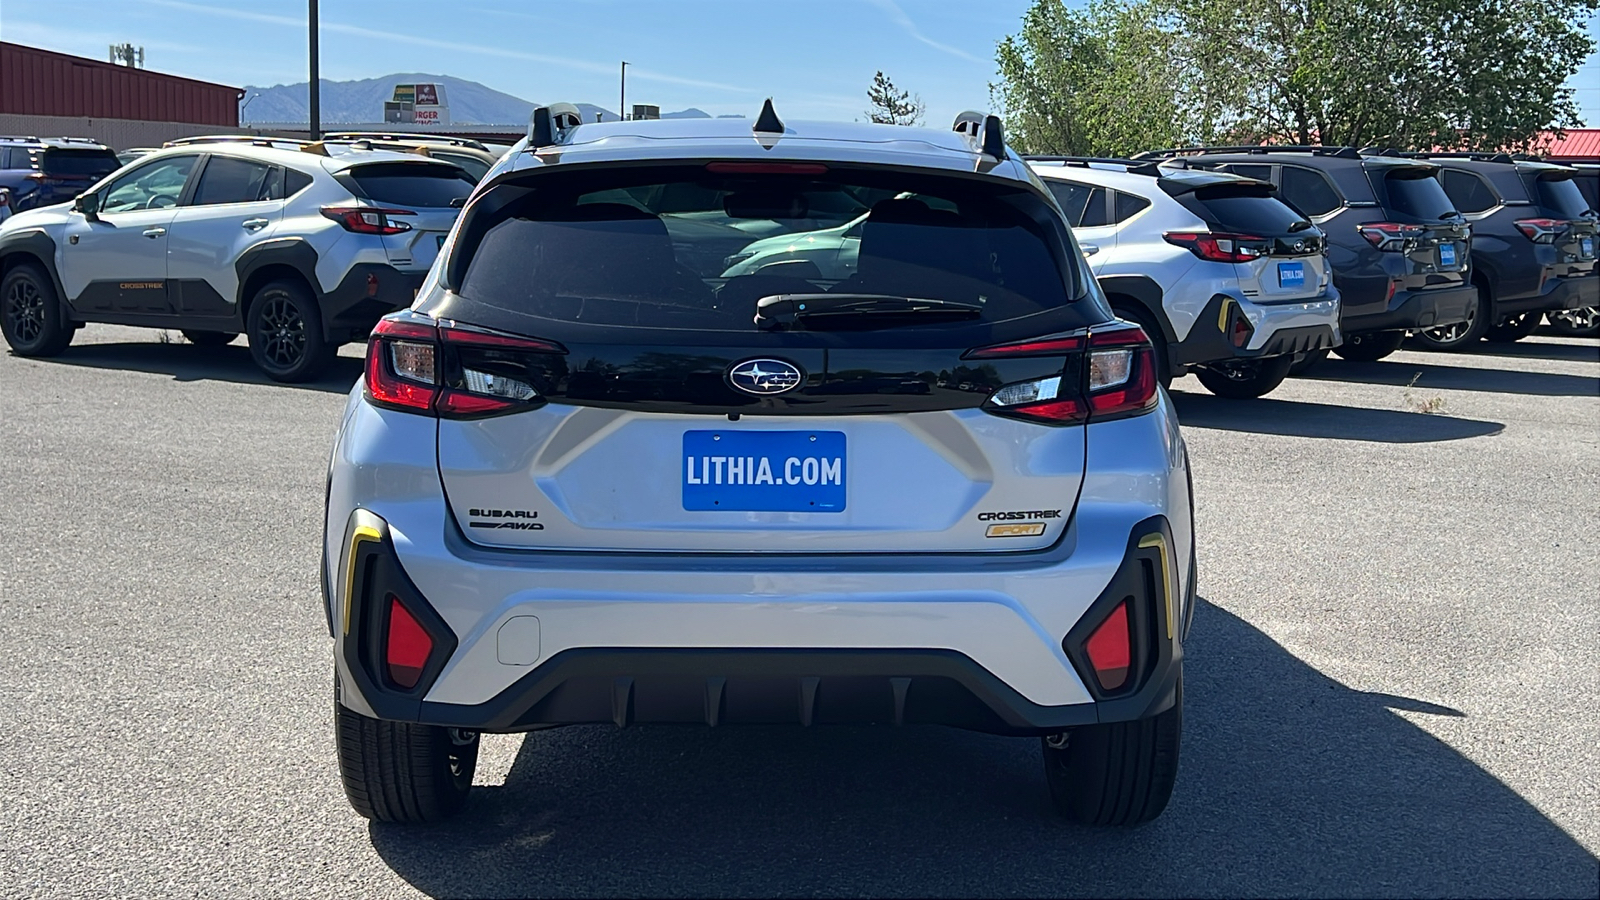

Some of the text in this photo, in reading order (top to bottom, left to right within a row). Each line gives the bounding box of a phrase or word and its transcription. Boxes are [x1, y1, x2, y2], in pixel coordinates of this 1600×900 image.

[414, 111, 438, 119] RGER
[687, 456, 842, 486] LITHIA.COM
[469, 508, 538, 519] SUBARU
[977, 509, 1061, 521] CROSSTREK
[497, 522, 545, 530] AWD
[991, 525, 1041, 535] SPORT
